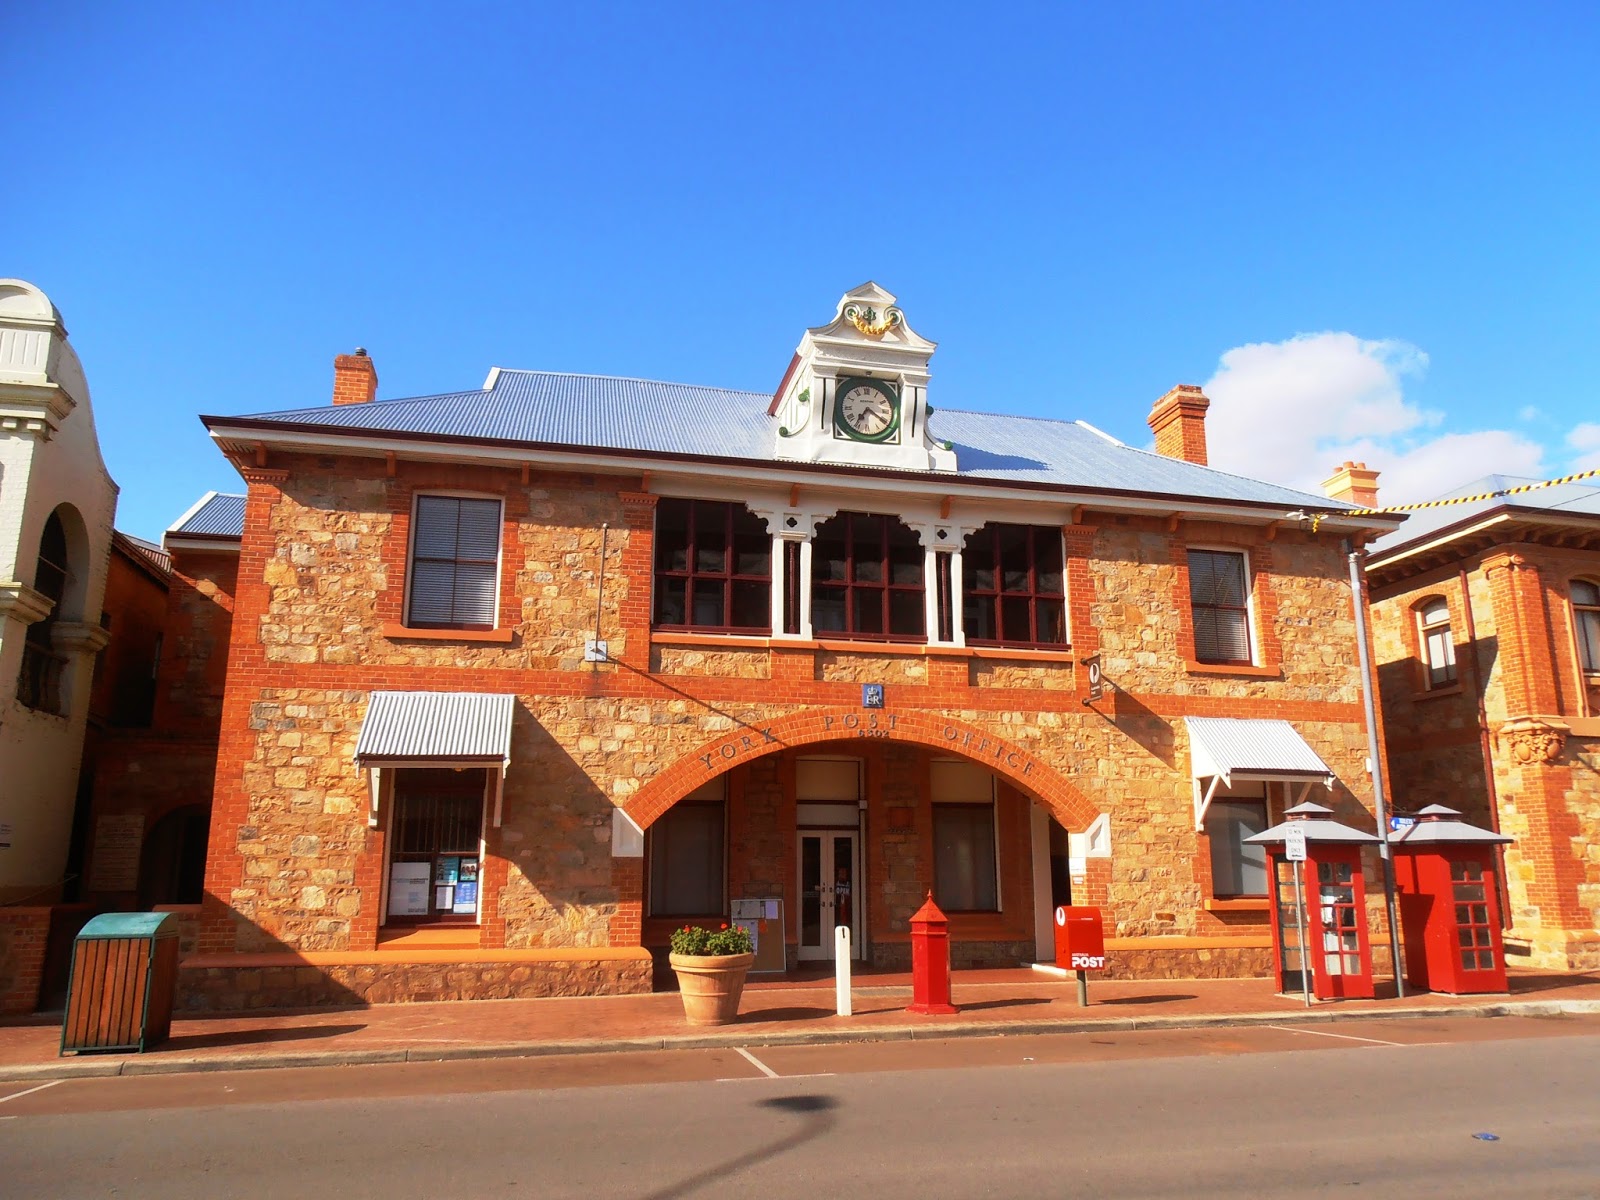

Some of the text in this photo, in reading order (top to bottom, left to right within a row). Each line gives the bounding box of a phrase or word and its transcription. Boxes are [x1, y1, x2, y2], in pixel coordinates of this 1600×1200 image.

[699, 713, 1035, 777] YORK POST OFFICE
[1071, 956, 1105, 968] POST
